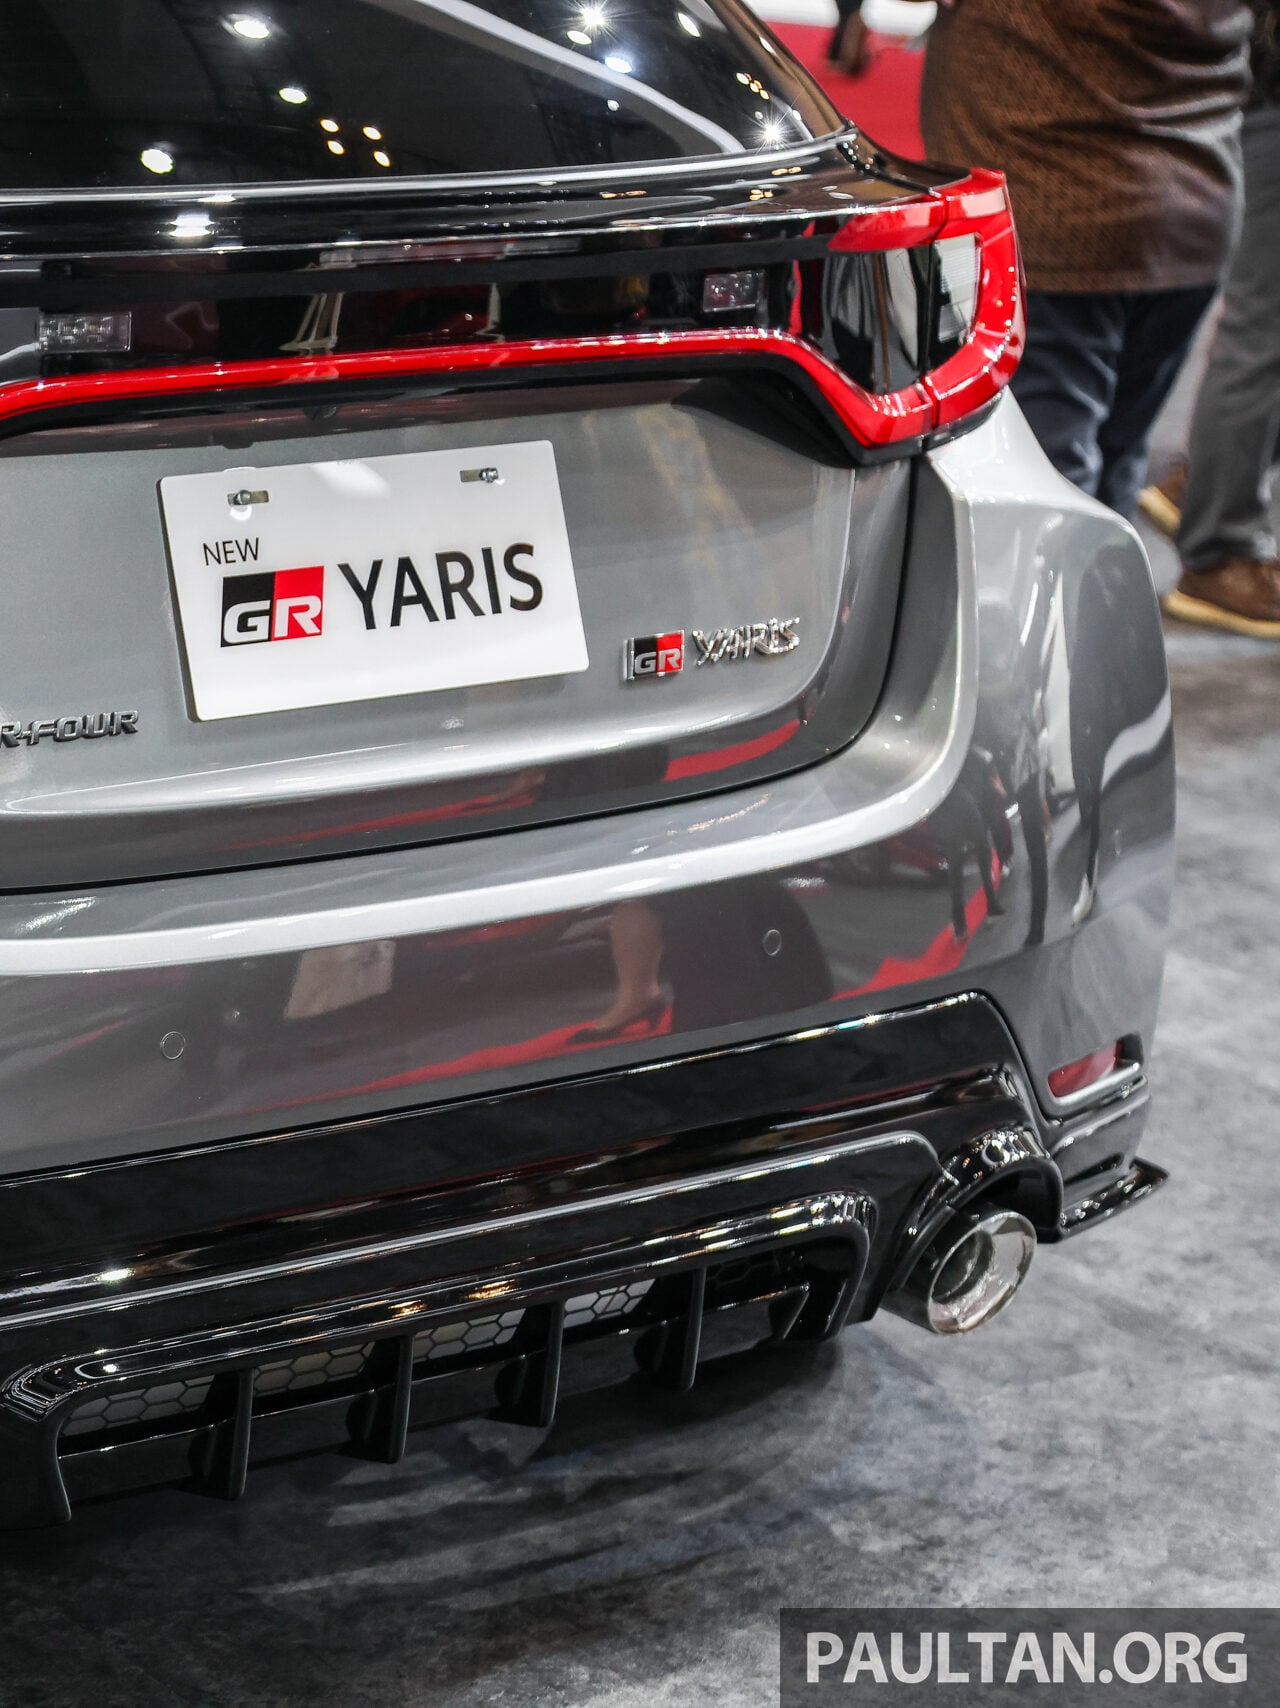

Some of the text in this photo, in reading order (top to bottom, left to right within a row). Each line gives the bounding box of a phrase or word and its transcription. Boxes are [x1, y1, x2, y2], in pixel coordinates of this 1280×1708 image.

[202, 537, 260, 566] NEW
[222, 542, 544, 644] GR YARIS
[691, 616, 801, 667] YARIS
